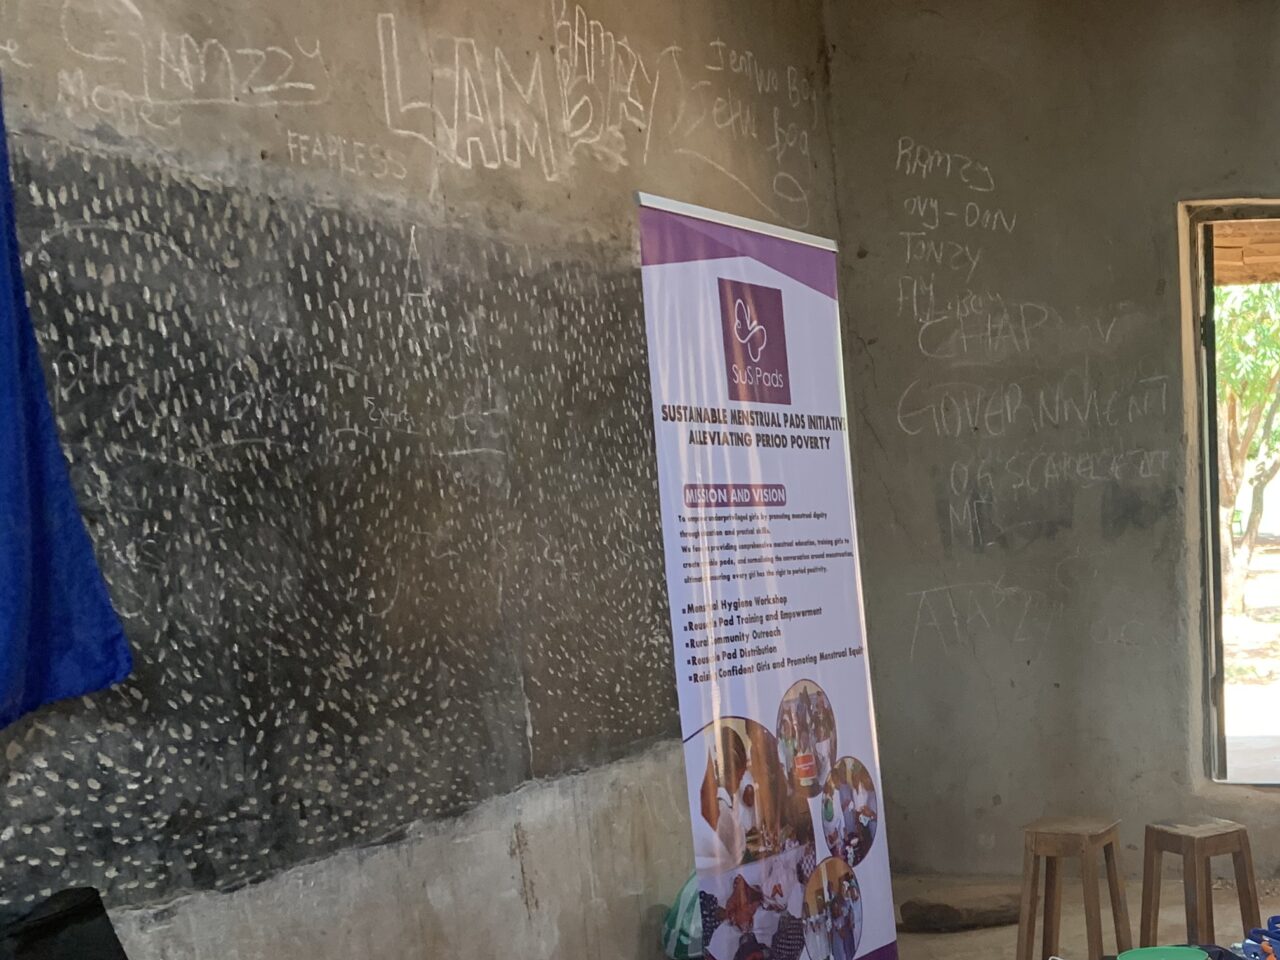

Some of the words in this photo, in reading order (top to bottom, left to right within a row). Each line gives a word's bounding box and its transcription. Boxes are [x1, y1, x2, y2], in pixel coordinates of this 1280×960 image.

[756, 368, 784, 388] Pads
[661, 405, 728, 425] SUSTAINABLE
[730, 409, 782, 428] MENSTRUAL
[783, 413, 806, 430] PADS
[688, 430, 752, 448] ALLEVIATING
[756, 434, 788, 449] PERIOD
[790, 435, 831, 450] POVERTY
[685, 488, 727, 503] MISSION
[731, 488, 750, 503] AND
[752, 487, 786, 502] VISION
[721, 597, 753, 612] Hygiene
[754, 594, 787, 607] Workshop
[718, 615, 734, 627] Pad
[736, 612, 764, 625] Training
[765, 610, 779, 621] and
[752, 626, 781, 640] Outreach
[718, 663, 754, 678] Confident
[756, 660, 771, 672] Girls
[772, 657, 786, 670] and
[786, 653, 818, 668] Promoting
[819, 648, 848, 662] Menstrual
[848, 645, 864, 659] Equit
[721, 648, 737, 661] Pad
[739, 644, 777, 658] Distribution
